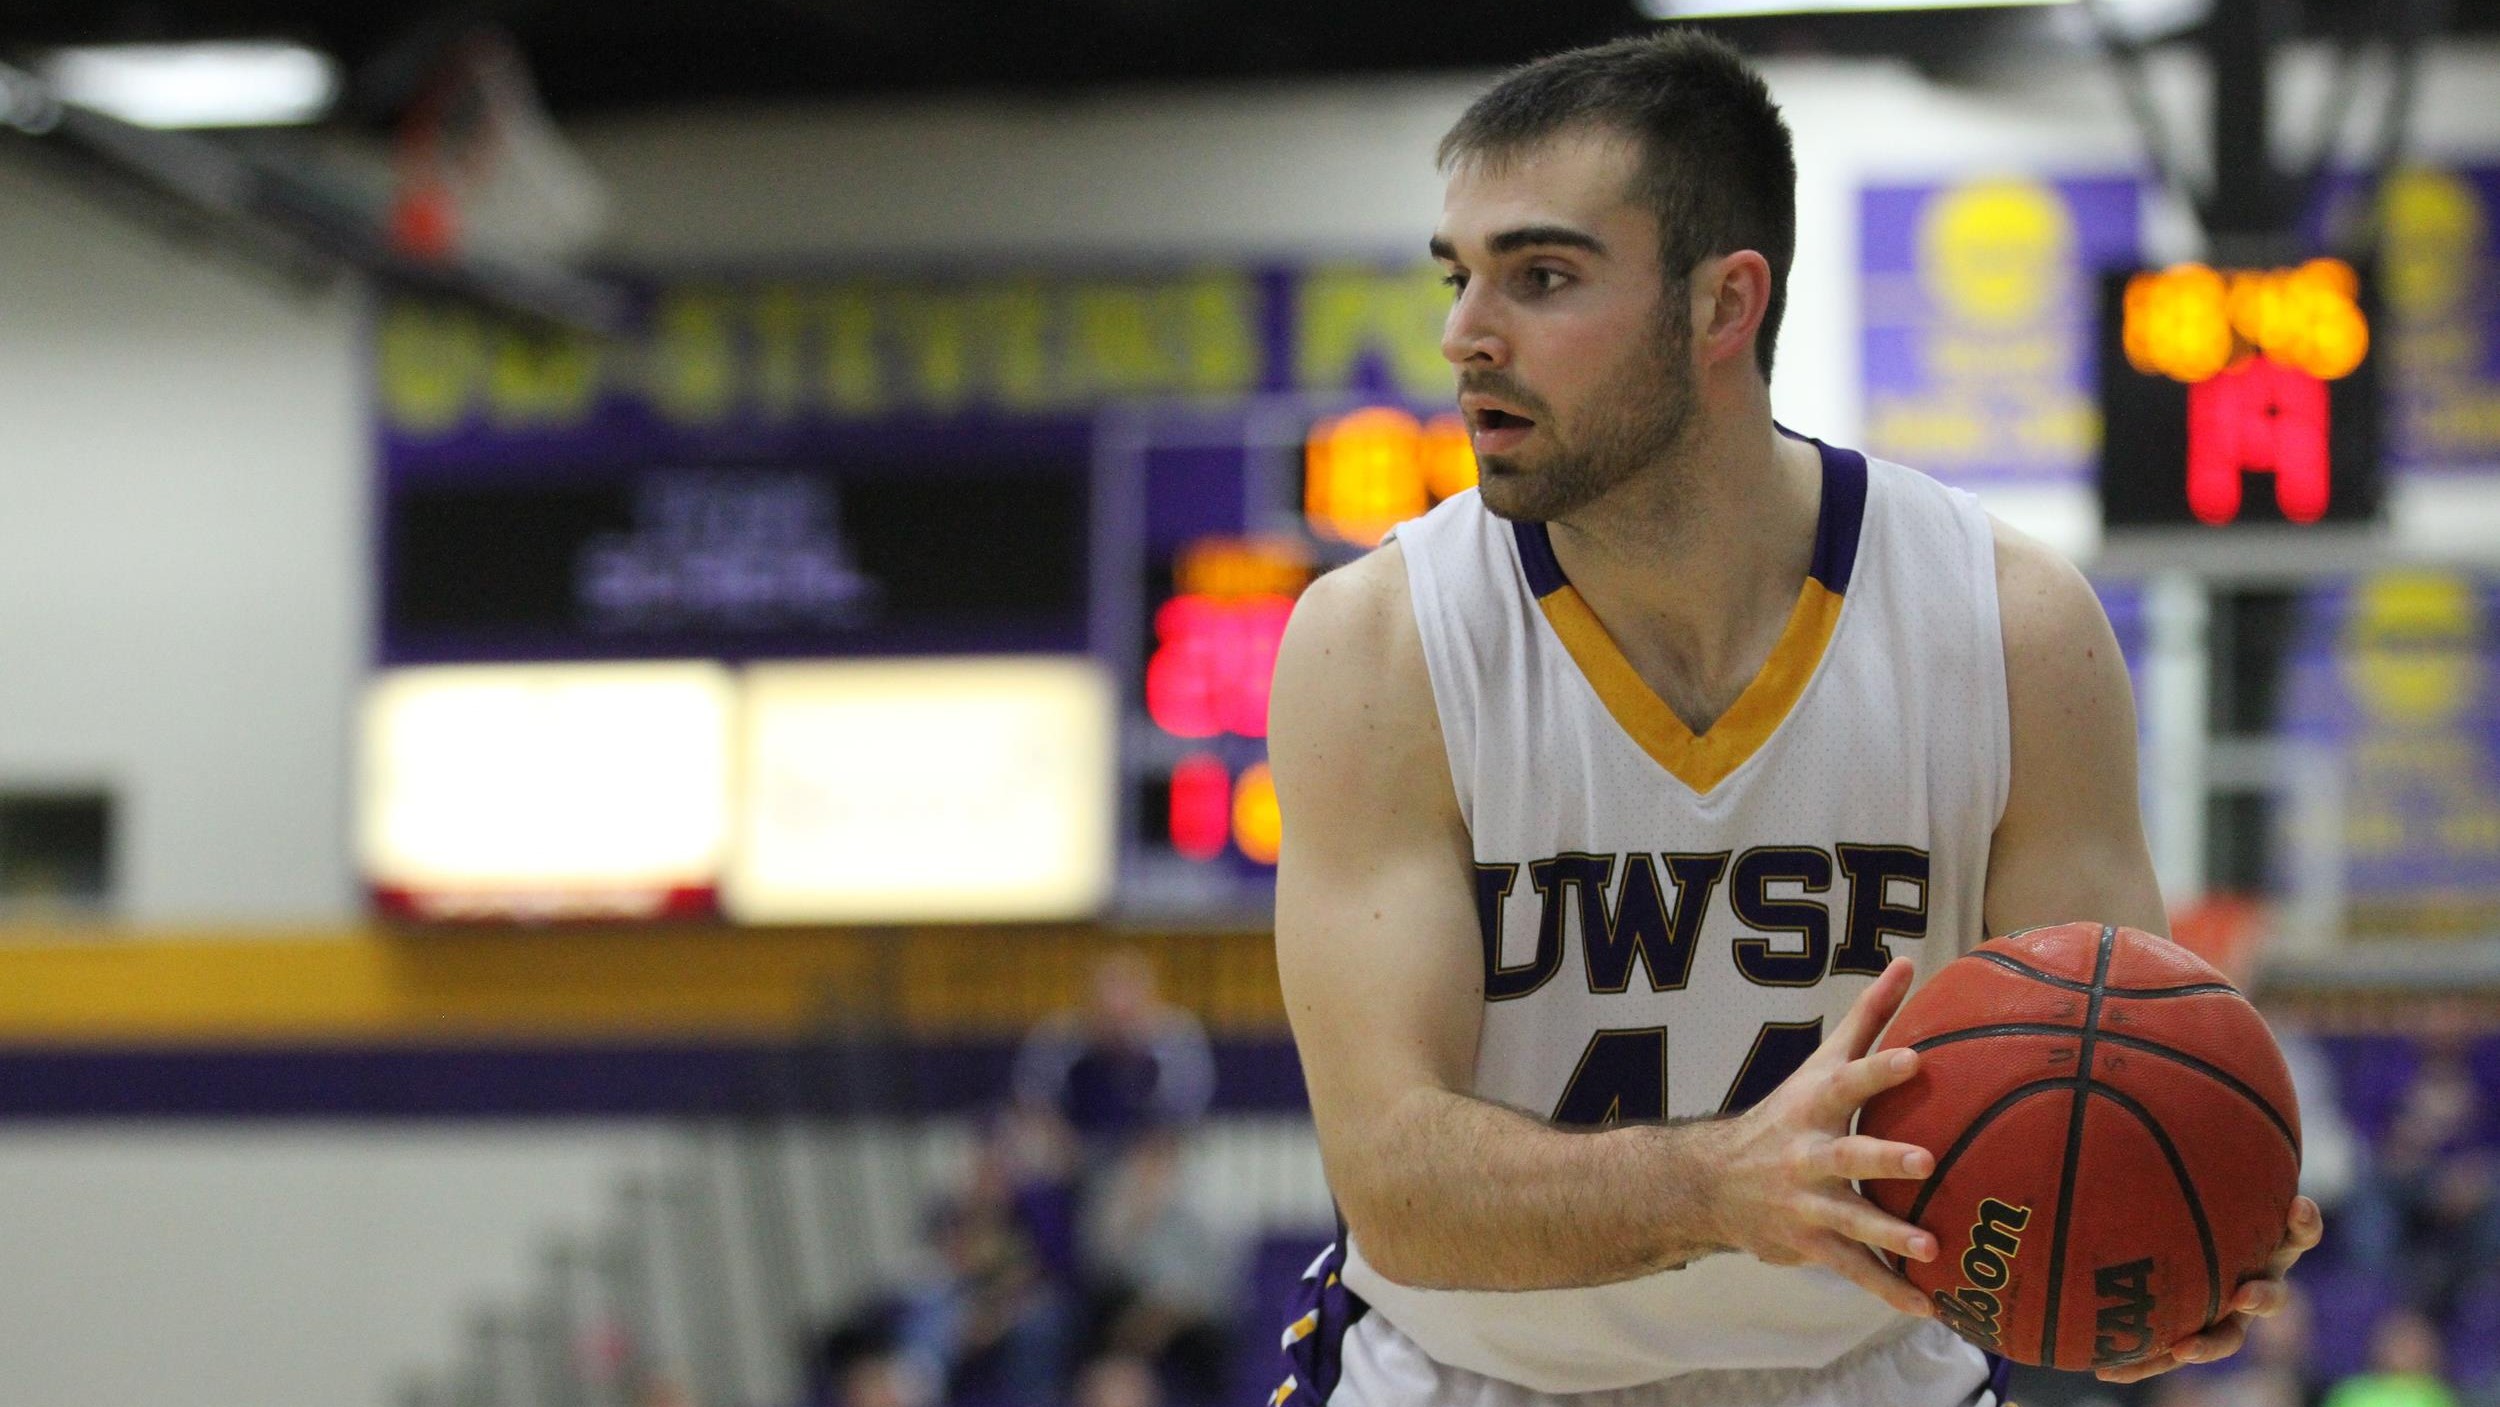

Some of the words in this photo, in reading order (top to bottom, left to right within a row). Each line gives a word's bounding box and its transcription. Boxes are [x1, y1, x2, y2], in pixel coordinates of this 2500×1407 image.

[1475, 842, 1930, 1002] UWSP
[1934, 1197, 2033, 1348] ilson
[2090, 1256, 2157, 1366] CAA
